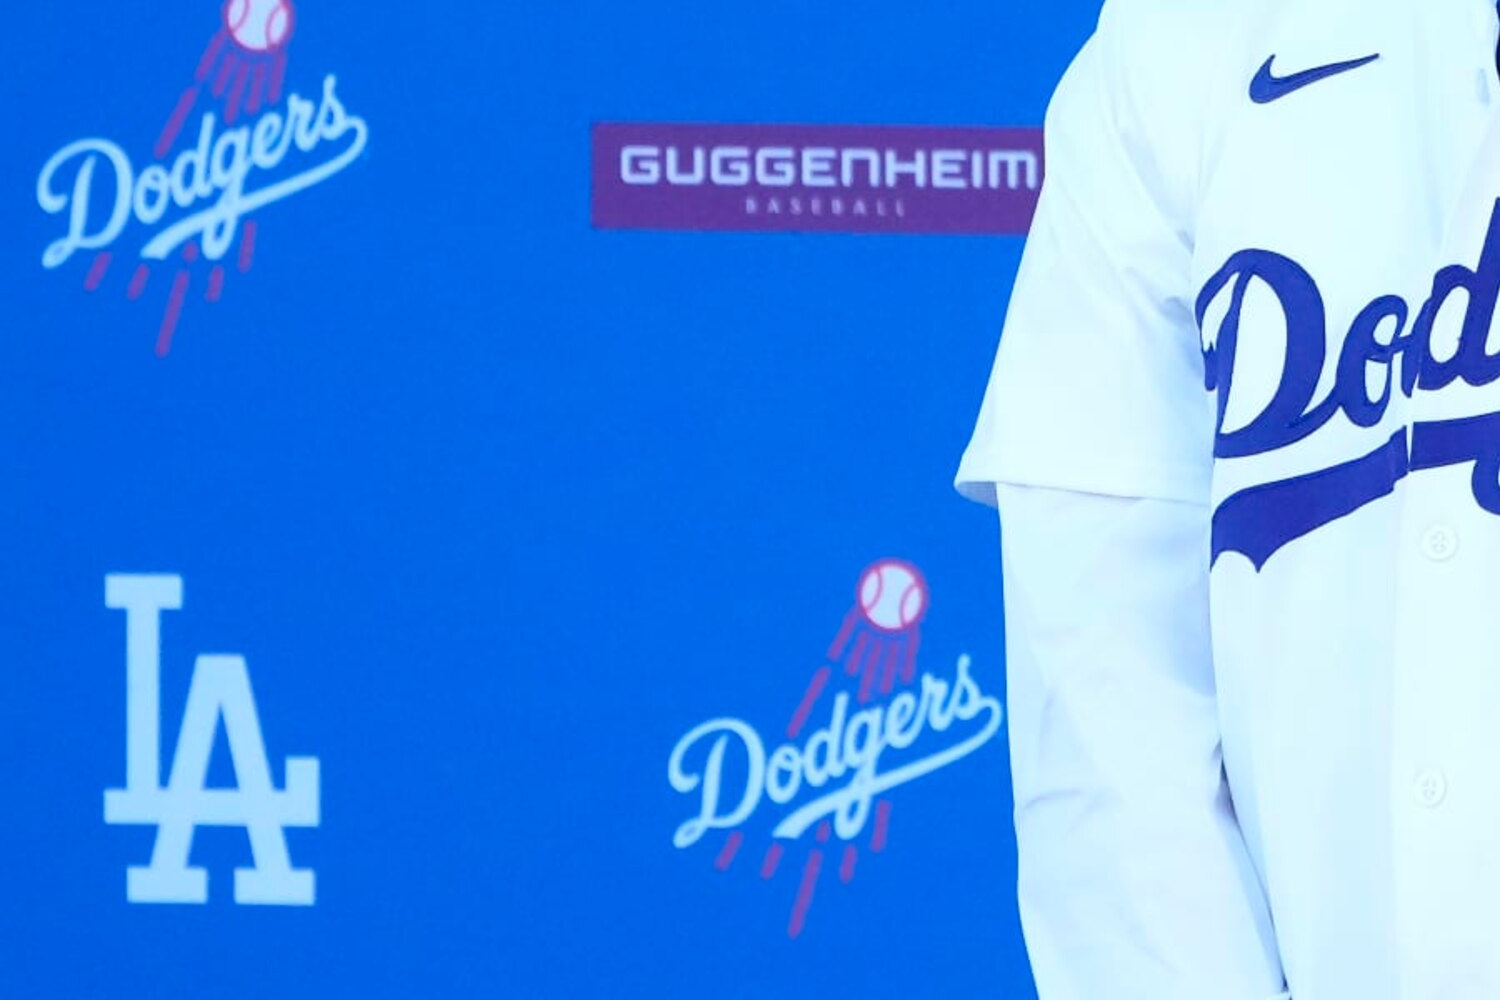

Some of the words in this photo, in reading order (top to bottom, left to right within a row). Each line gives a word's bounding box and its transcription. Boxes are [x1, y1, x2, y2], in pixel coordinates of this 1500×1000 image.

[37, 74, 368, 268] Dodgers
[619, 145, 1039, 190] GUGGENHEIM
[745, 196, 906, 217] BASEBALL
[104, 573, 321, 906] LA
[668, 654, 1001, 848] Dodgers
